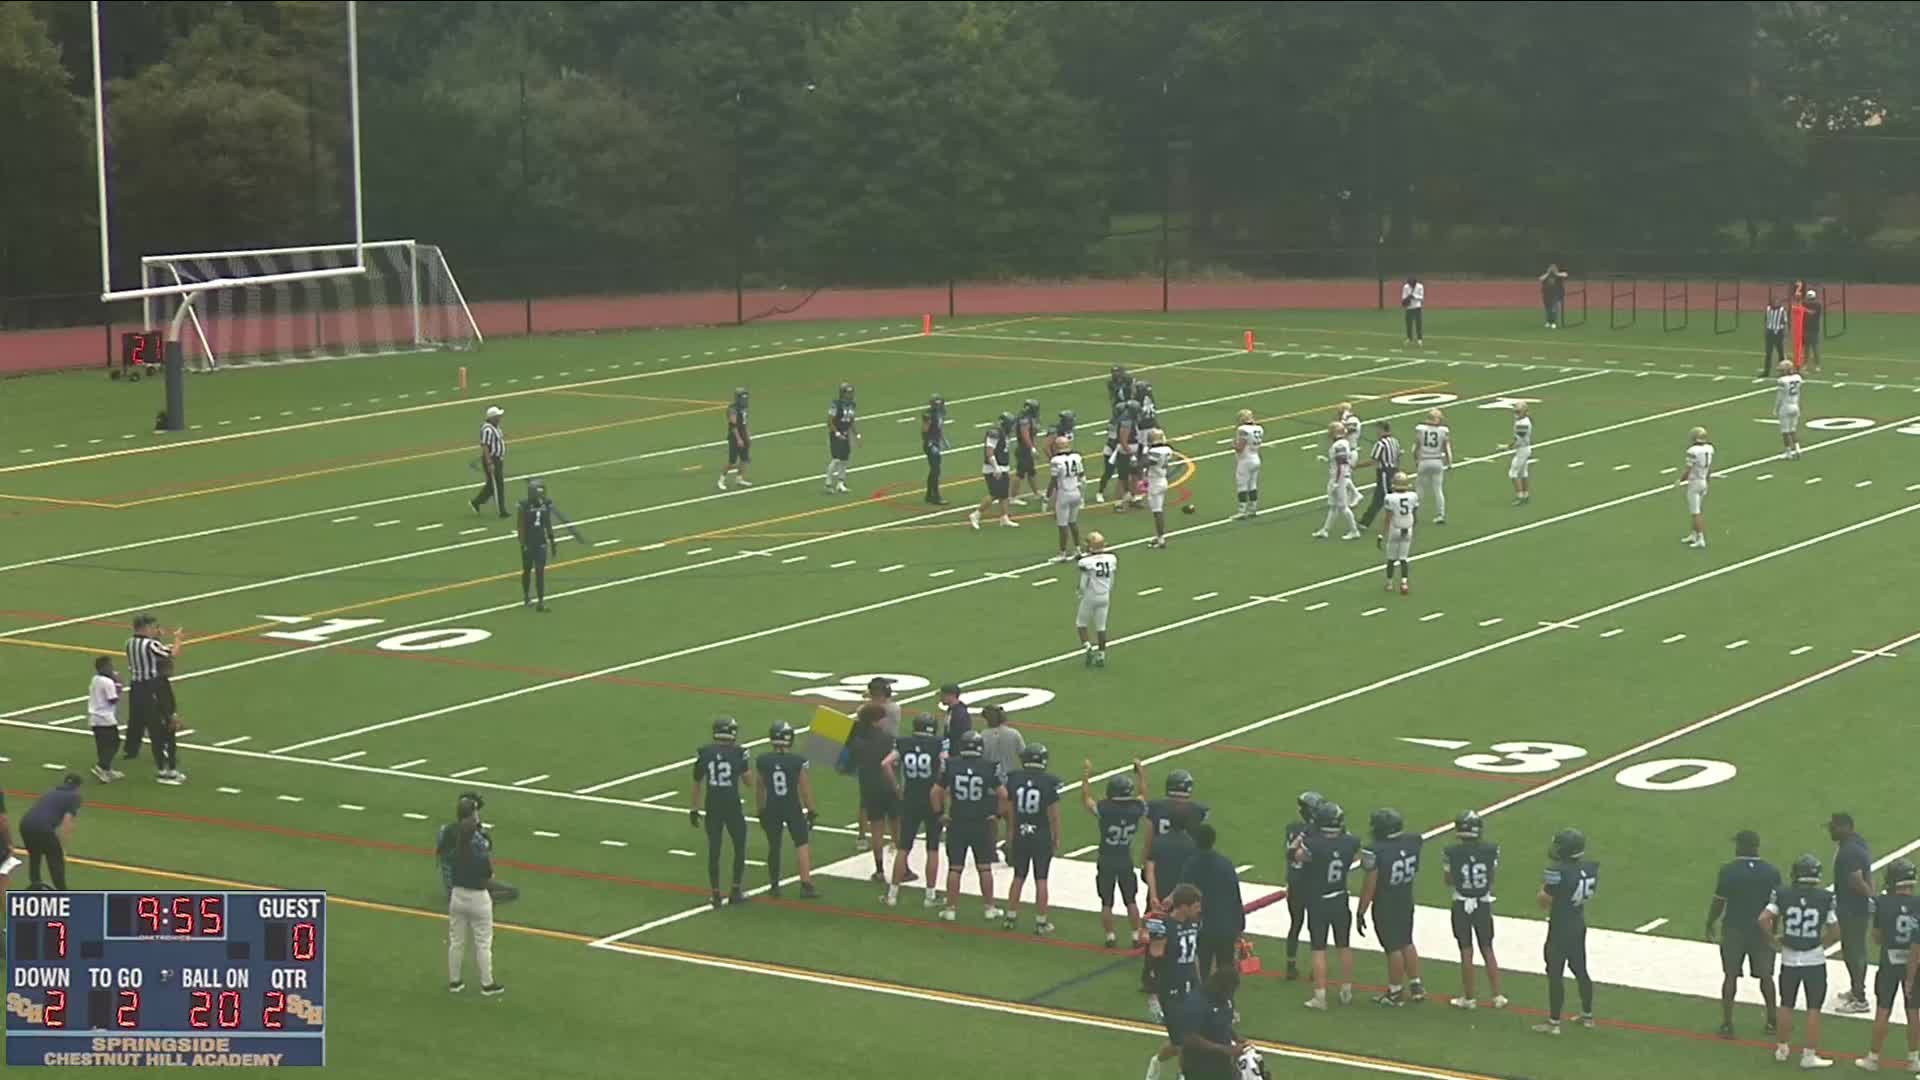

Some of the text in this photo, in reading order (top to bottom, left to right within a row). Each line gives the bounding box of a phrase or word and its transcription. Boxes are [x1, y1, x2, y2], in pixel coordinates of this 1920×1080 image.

[131, 335, 161, 365] 21
[1423, 432, 1438, 448] 13
[1064, 459, 1078, 478] 14
[1399, 498, 1409, 516] 5
[707, 760, 732, 787] 12
[903, 752, 931, 779] 99
[772, 770, 788, 797] 8
[954, 775, 984, 802] 56
[1016, 787, 1041, 814] 18
[1327, 859, 1343, 884] 6
[1390, 856, 1417, 886] 65
[1461, 863, 1488, 889] 16
[1571, 876, 1597, 908] 45
[1785, 906, 1820, 938] 22
